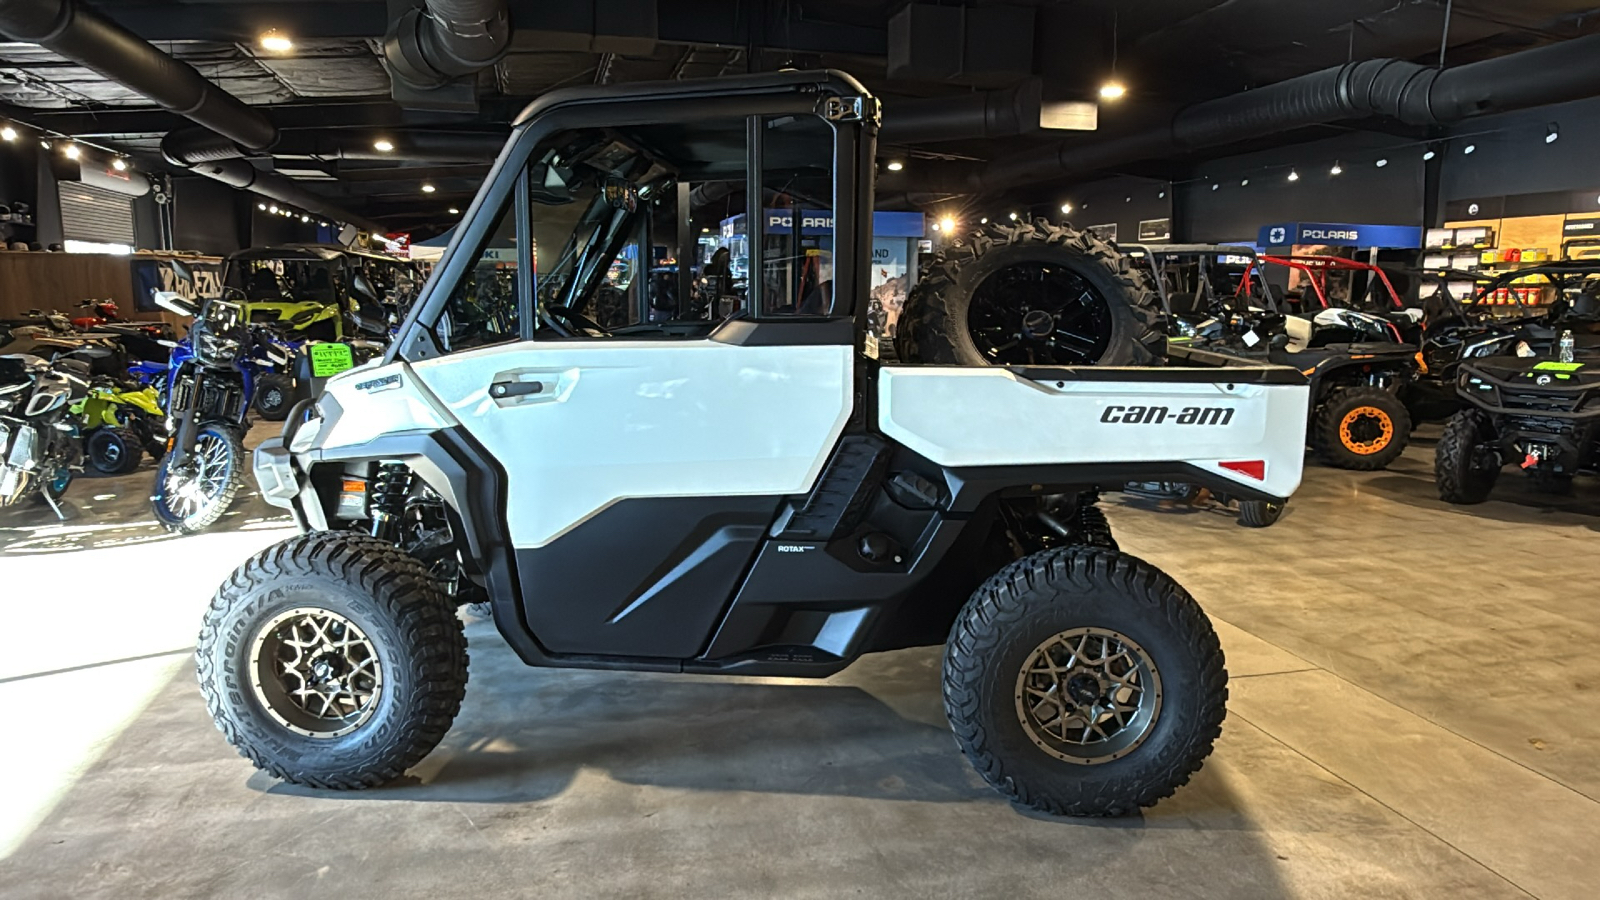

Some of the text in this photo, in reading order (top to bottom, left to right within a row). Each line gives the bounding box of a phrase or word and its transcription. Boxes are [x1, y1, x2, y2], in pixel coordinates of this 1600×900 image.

[769, 216, 834, 227] POARIS
[1302, 230, 1358, 240] POLARIS
[1100, 405, 1235, 426] can-am
